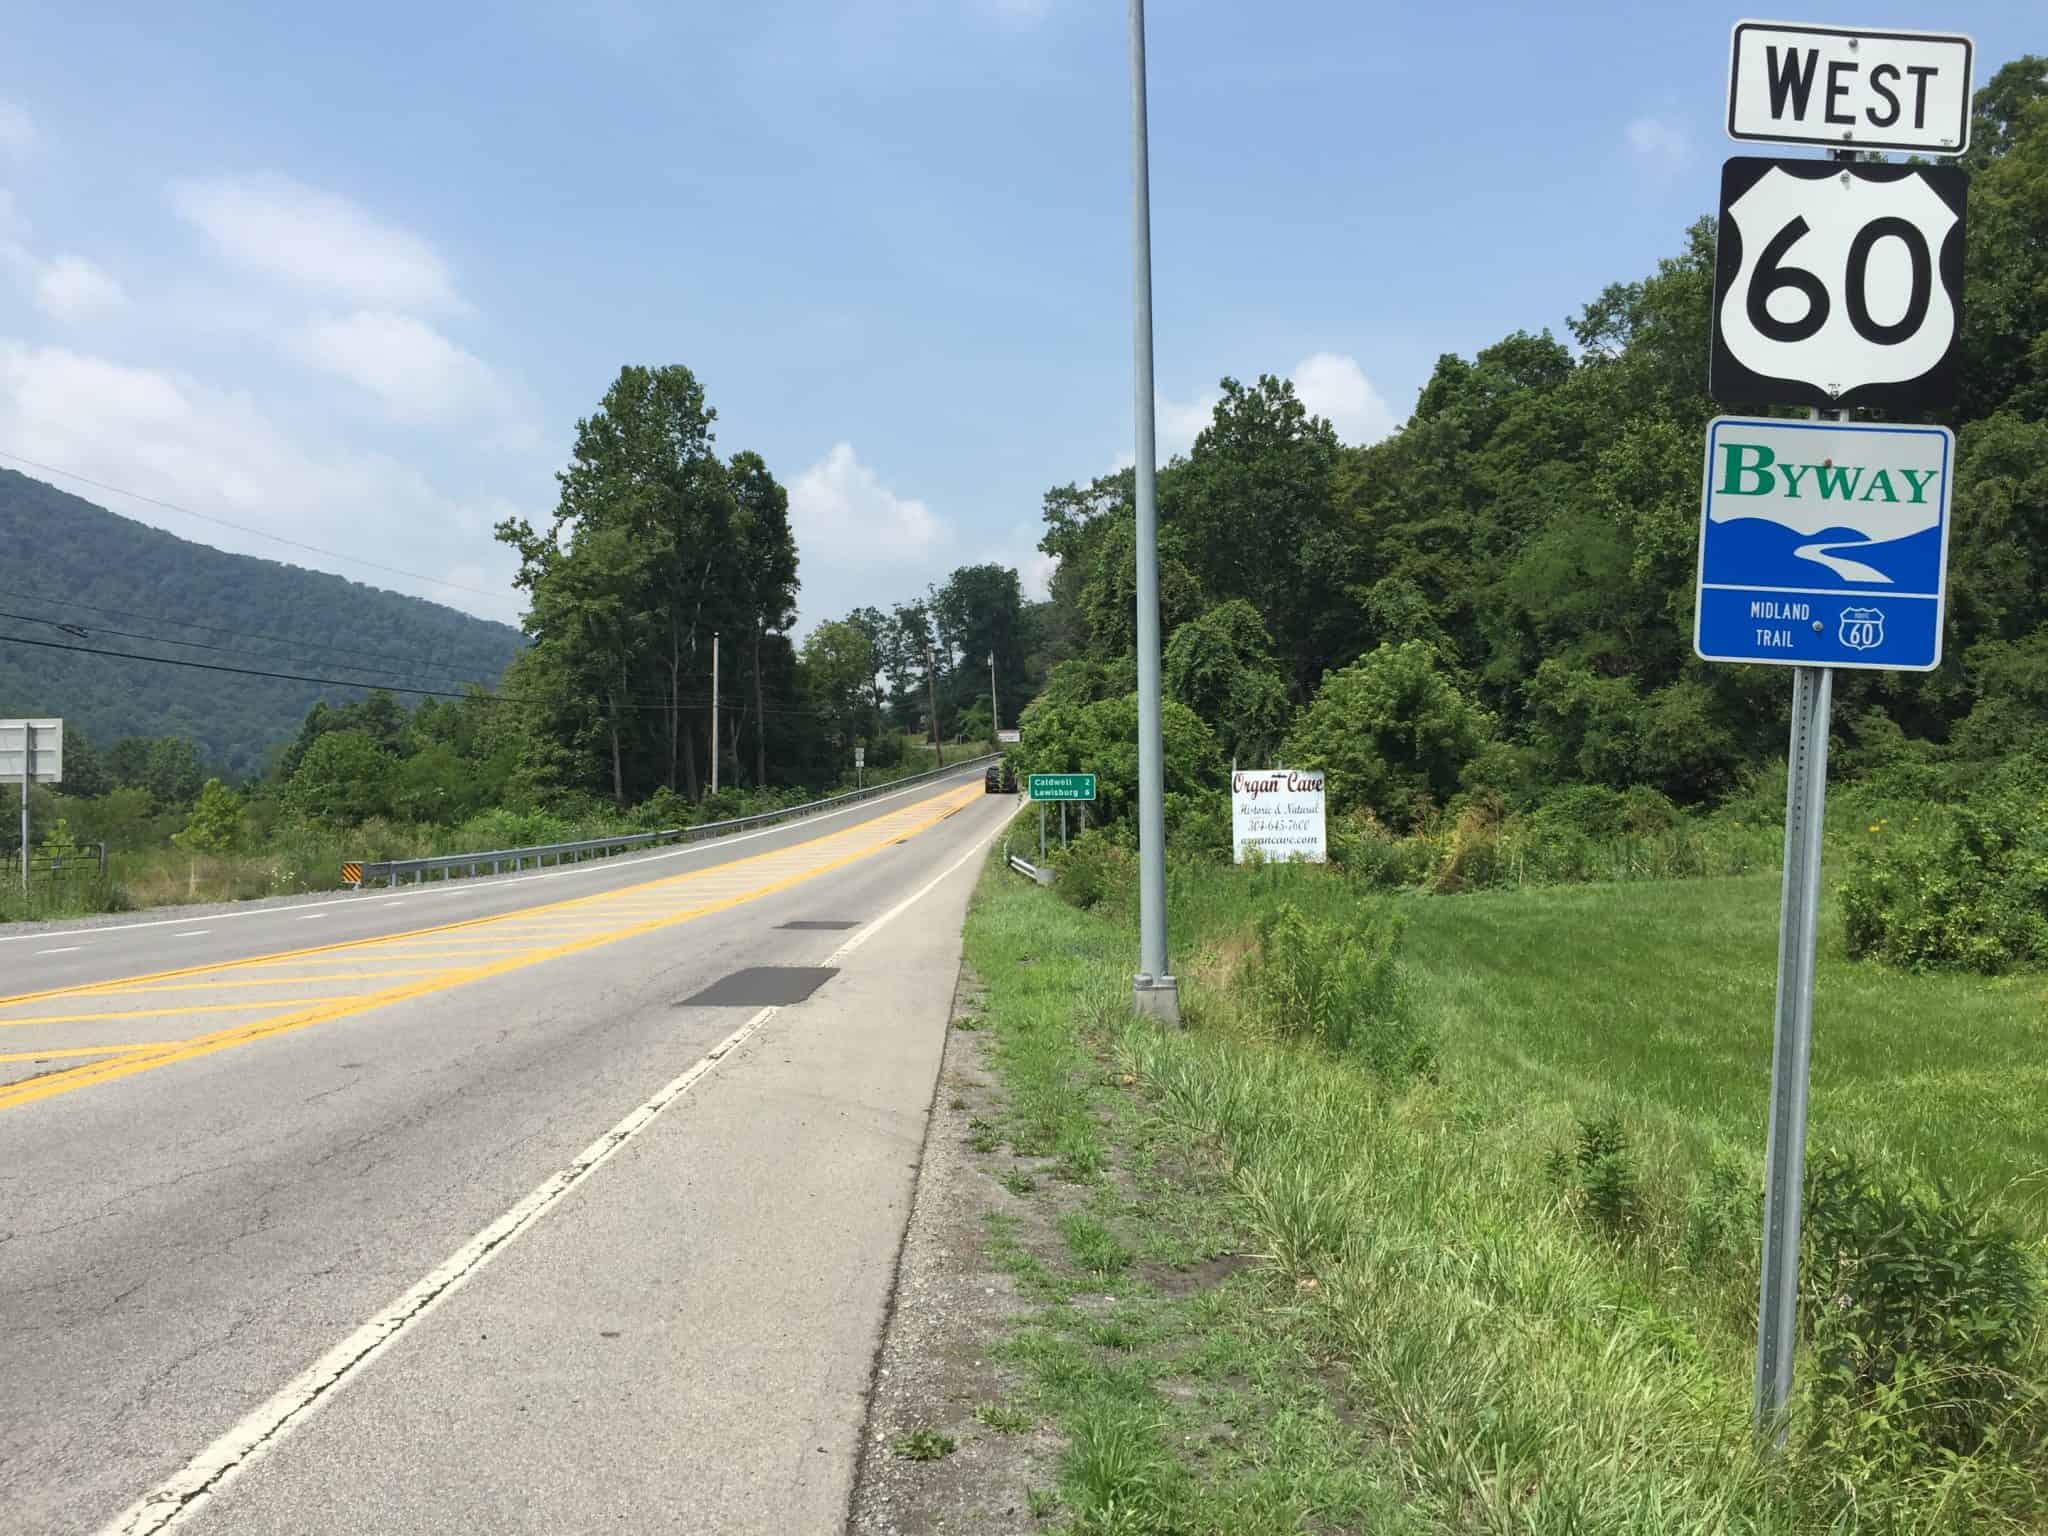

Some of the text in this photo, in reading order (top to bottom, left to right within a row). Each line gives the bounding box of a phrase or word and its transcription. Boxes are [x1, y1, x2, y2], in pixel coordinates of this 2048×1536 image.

[1766, 46, 1939, 129] WEST
[1746, 214, 1932, 346] 60
[1715, 443, 1939, 504] BYWAY
[1751, 601, 1810, 621] MIDLAND
[1756, 629, 1794, 648] TRAIL
[1850, 623, 1873, 646] 60
[1034, 778, 1090, 786] Caldwell 2
[1034, 789, 1079, 797] Lewisburg
[1233, 771, 1323, 800] Organ Cave
